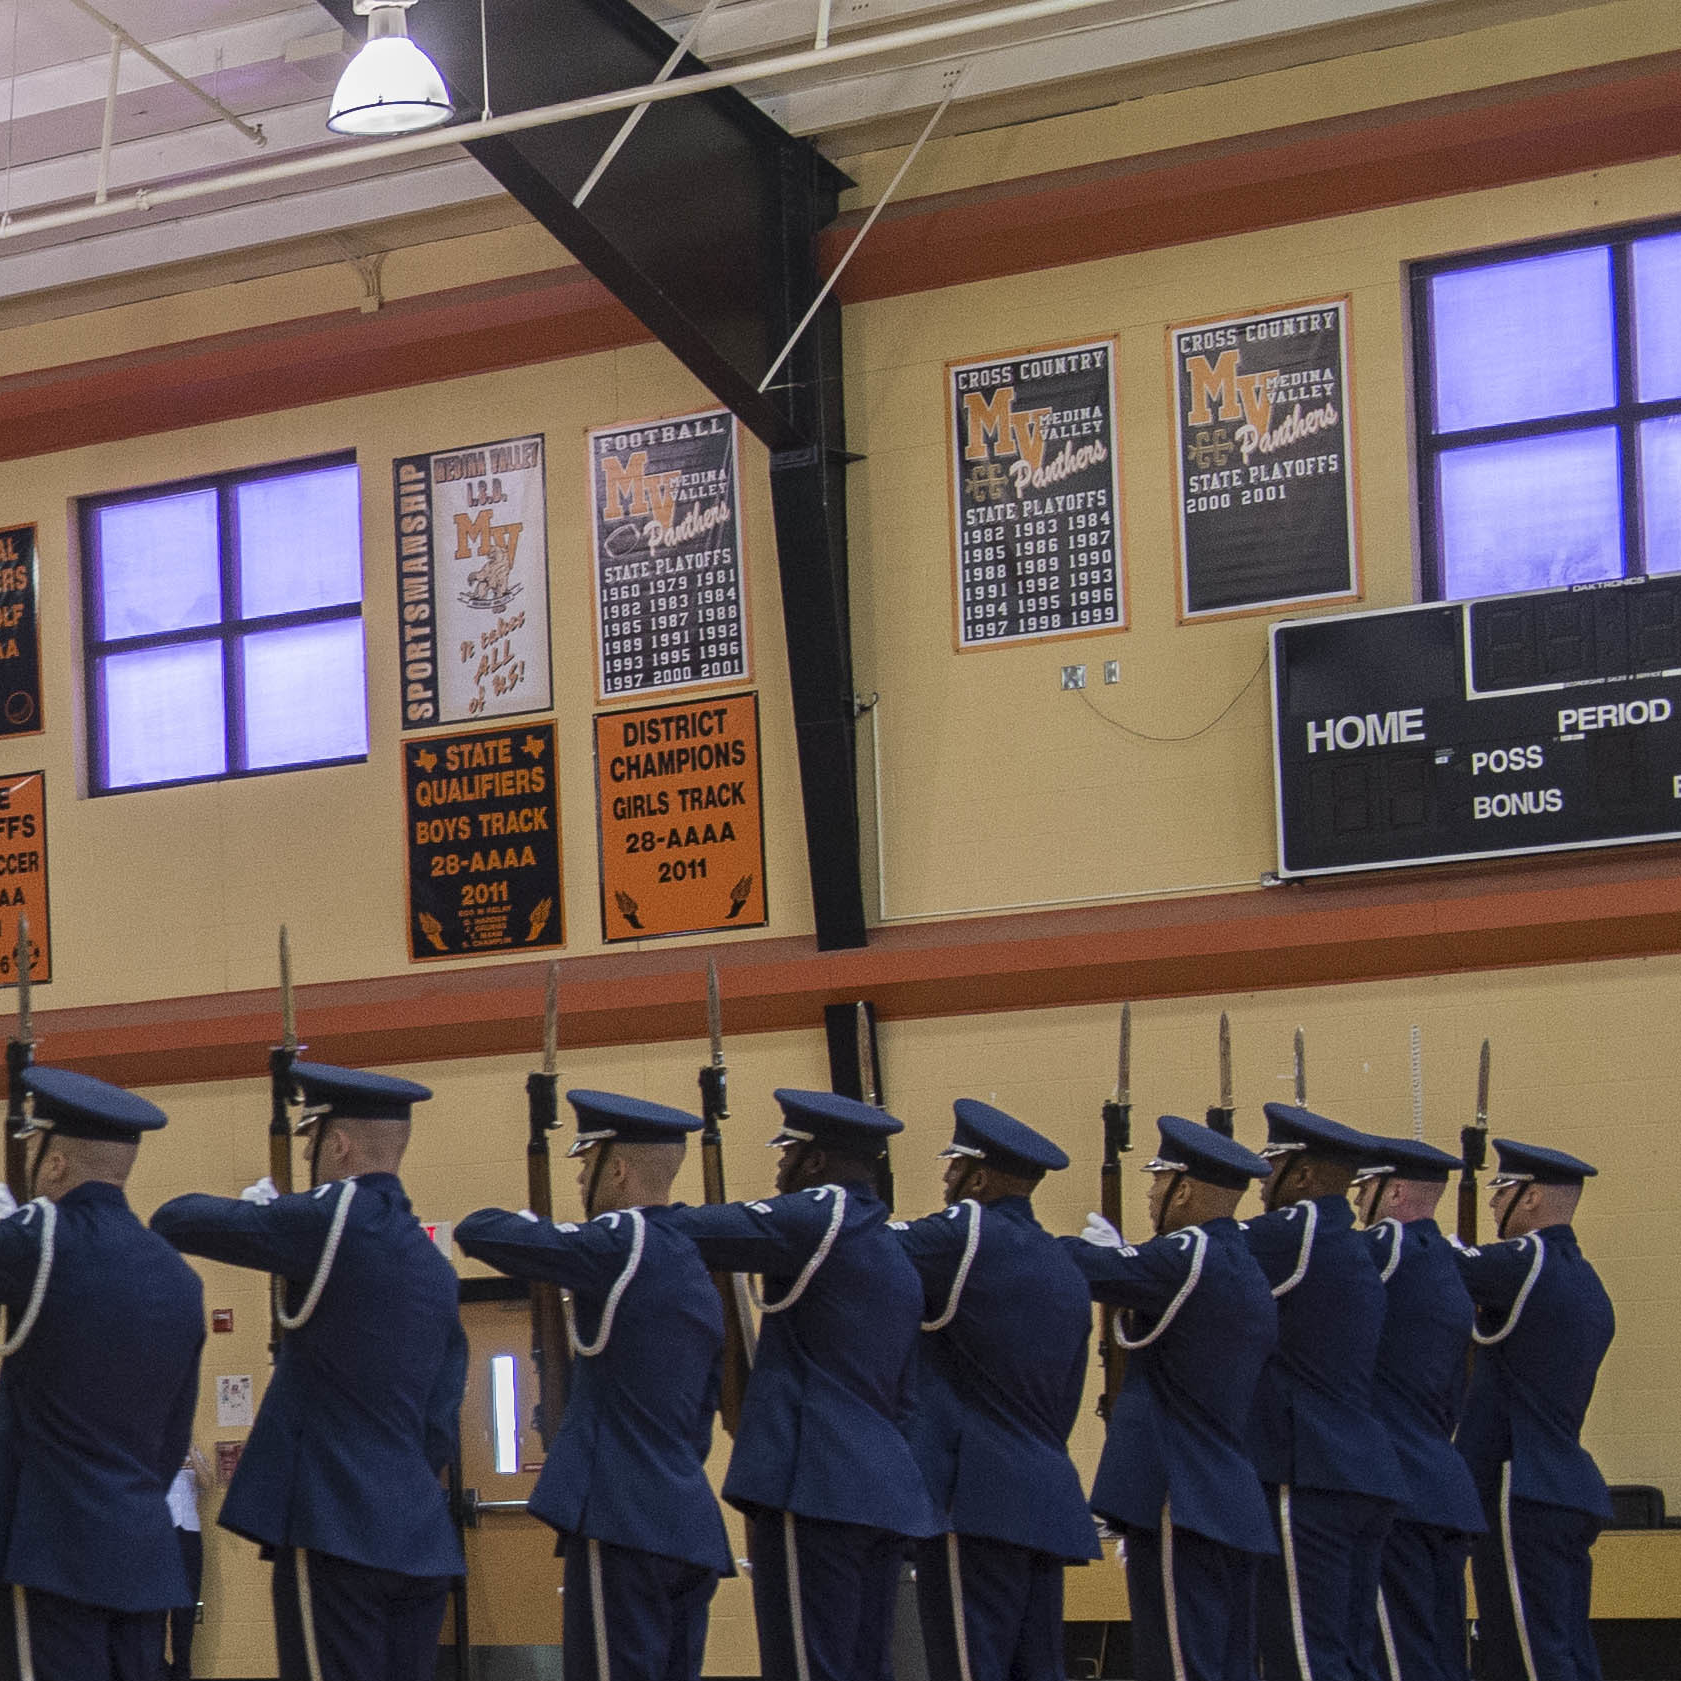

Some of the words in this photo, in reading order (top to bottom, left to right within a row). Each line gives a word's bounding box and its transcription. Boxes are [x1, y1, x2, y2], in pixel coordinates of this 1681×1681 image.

[1180, 329, 1236, 354] CROSS
[1246, 312, 1335, 343] COUNTRY
[958, 366, 1011, 391] CROSS
[1021, 350, 1104, 380] COUNTRY
[1266, 368, 1333, 389] MEDINA
[1266, 383, 1334, 404] VALLEY
[1039, 407, 1103, 426] MEDINA
[1040, 420, 1103, 441] VALLEY
[600, 418, 724, 453] FOOTBALL
[1235, 403, 1338, 465] Panthers
[669, 469, 726, 488] MEDINA
[1010, 440, 1106, 499] Panthers
[1189, 469, 1241, 493] STATE
[1249, 454, 1338, 485] PLAYOFFS
[670, 482, 726, 502] VALLEY
[966, 503, 1016, 526] STATE
[1022, 489, 1106, 518] PLAYOFFS
[1186, 494, 1230, 513] 2000
[1241, 486, 1287, 505] 2001
[643, 499, 730, 556] Panthers
[964, 527, 1004, 545] 1982
[1015, 520, 1057, 539] 1983
[1068, 511, 1110, 530] 1984
[964, 546, 1005, 565] 1985
[1015, 539, 1058, 557] 1986
[1068, 531, 1111, 549] 1987
[604, 561, 649, 583] STATE
[656, 548, 731, 576] PLAYOFFS
[965, 565, 1006, 583] 1988
[1017, 558, 1059, 576] 1989
[1069, 549, 1112, 569] 1990
[400, 464, 434, 721] SPORTSMANSHIP
[602, 583, 639, 602] 1960
[649, 577, 687, 594] 1979
[697, 570, 735, 588] 1981
[965, 585, 1007, 602] 1991
[1017, 577, 1059, 595] 1992
[1070, 569, 1112, 588] 1993
[1572, 576, 1645, 592] DAKTRONICS
[603, 601, 641, 620] 1982
[650, 594, 689, 613] 1983
[697, 587, 736, 605] 1984
[966, 604, 1007, 621] 1994
[1018, 596, 1060, 613] 1995
[1070, 588, 1113, 607] 1996
[604, 619, 642, 638] 1985
[651, 612, 689, 631] 1987
[605, 638, 643, 656] 1989
[651, 631, 689, 649] 1991
[699, 623, 738, 642] 1992
[966, 622, 1008, 640] 1997
[1018, 615, 1060, 633] 1998
[1072, 608, 1114, 626] 1999
[605, 656, 643, 674] 1993
[652, 649, 690, 667] 1995
[700, 642, 739, 660] 1996
[606, 673, 644, 692] 1997
[653, 667, 691, 685] 2000
[700, 659, 739, 678] 2001
[623, 709, 727, 748] DISTRICT
[1307, 708, 1426, 753] HOME
[1558, 698, 1671, 732] PERIOD
[446, 738, 512, 771] STATE
[610, 740, 745, 782] CHAMPIONS
[1471, 745, 1544, 775] POSS
[416, 766, 544, 807] QUALIFIERS
[613, 791, 669, 821] GIRLS
[678, 781, 745, 813] TRACK
[1473, 788, 1563, 819] BONUS
[417, 818, 470, 845] BOYS
[479, 807, 548, 838] TRACK
[626, 822, 735, 854] 28-AAAA
[431, 846, 535, 877] 28-AAAA
[658, 858, 706, 883] 2011
[461, 882, 508, 906] 2011
